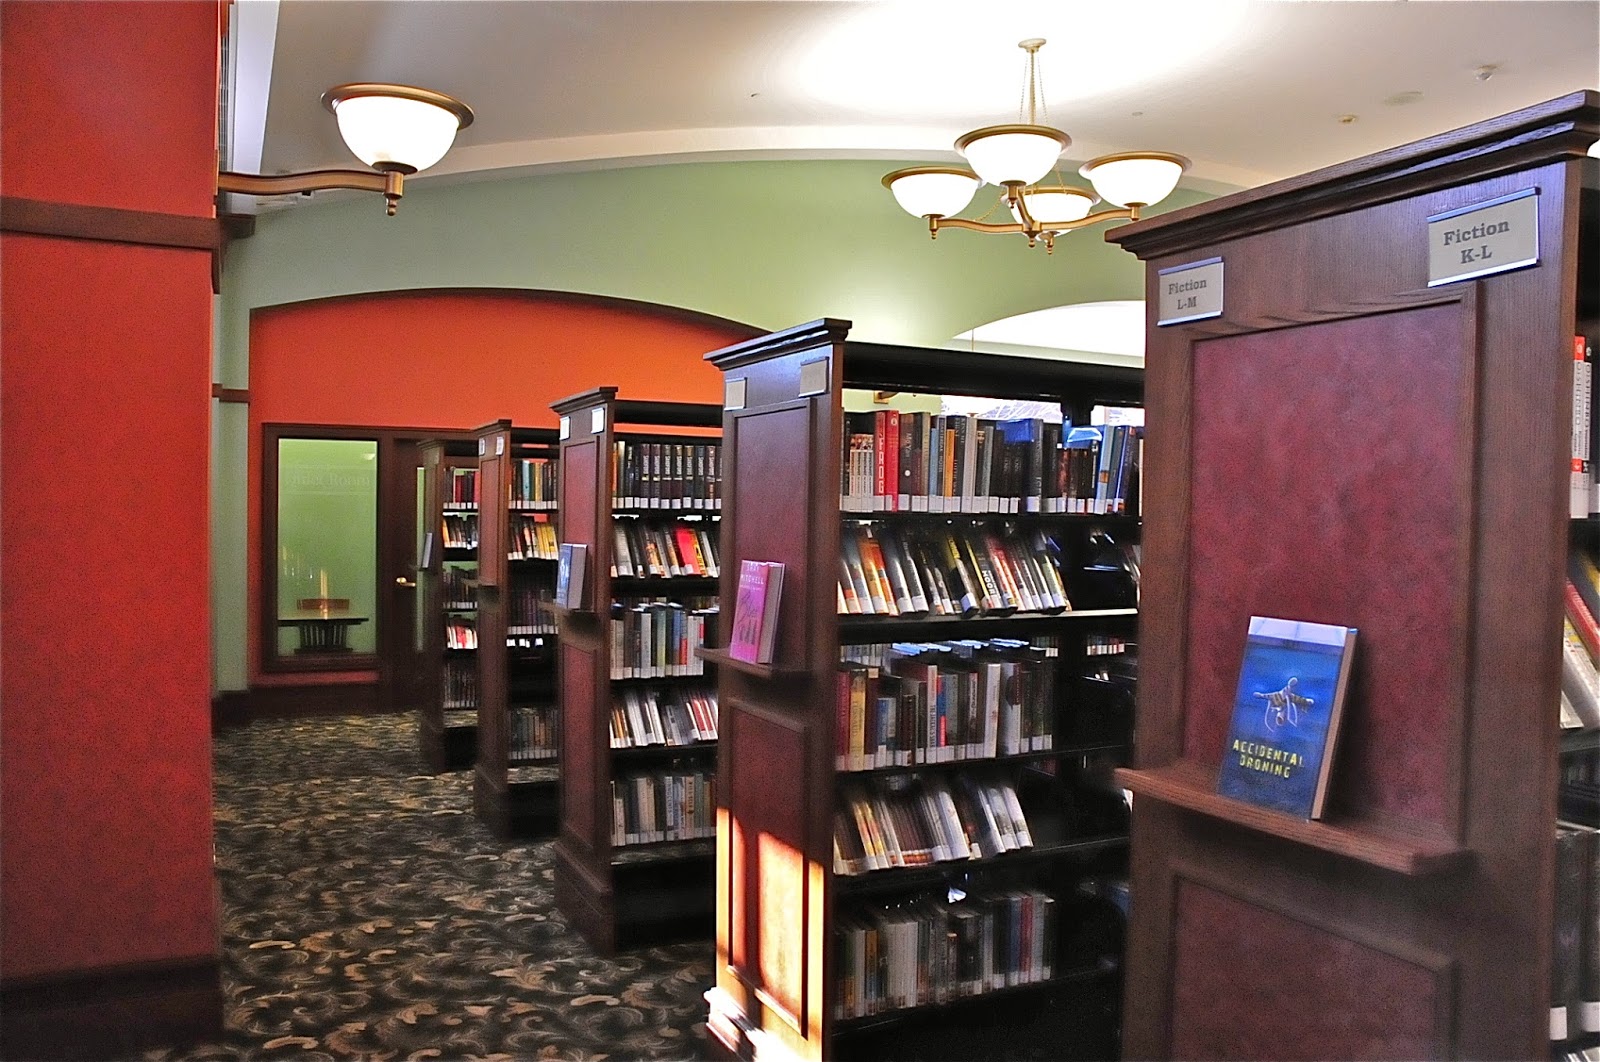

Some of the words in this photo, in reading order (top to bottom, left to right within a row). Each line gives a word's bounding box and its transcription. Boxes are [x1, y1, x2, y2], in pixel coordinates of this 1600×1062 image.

[1443, 221, 1510, 246] Fiction
[1460, 245, 1492, 264] K-L
[1168, 279, 1207, 295] Fiction
[1177, 296, 1197, 310] L-M
[1232, 739, 1305, 768] ACCIDENTAL
[1239, 753, 1291, 778] DRONING
